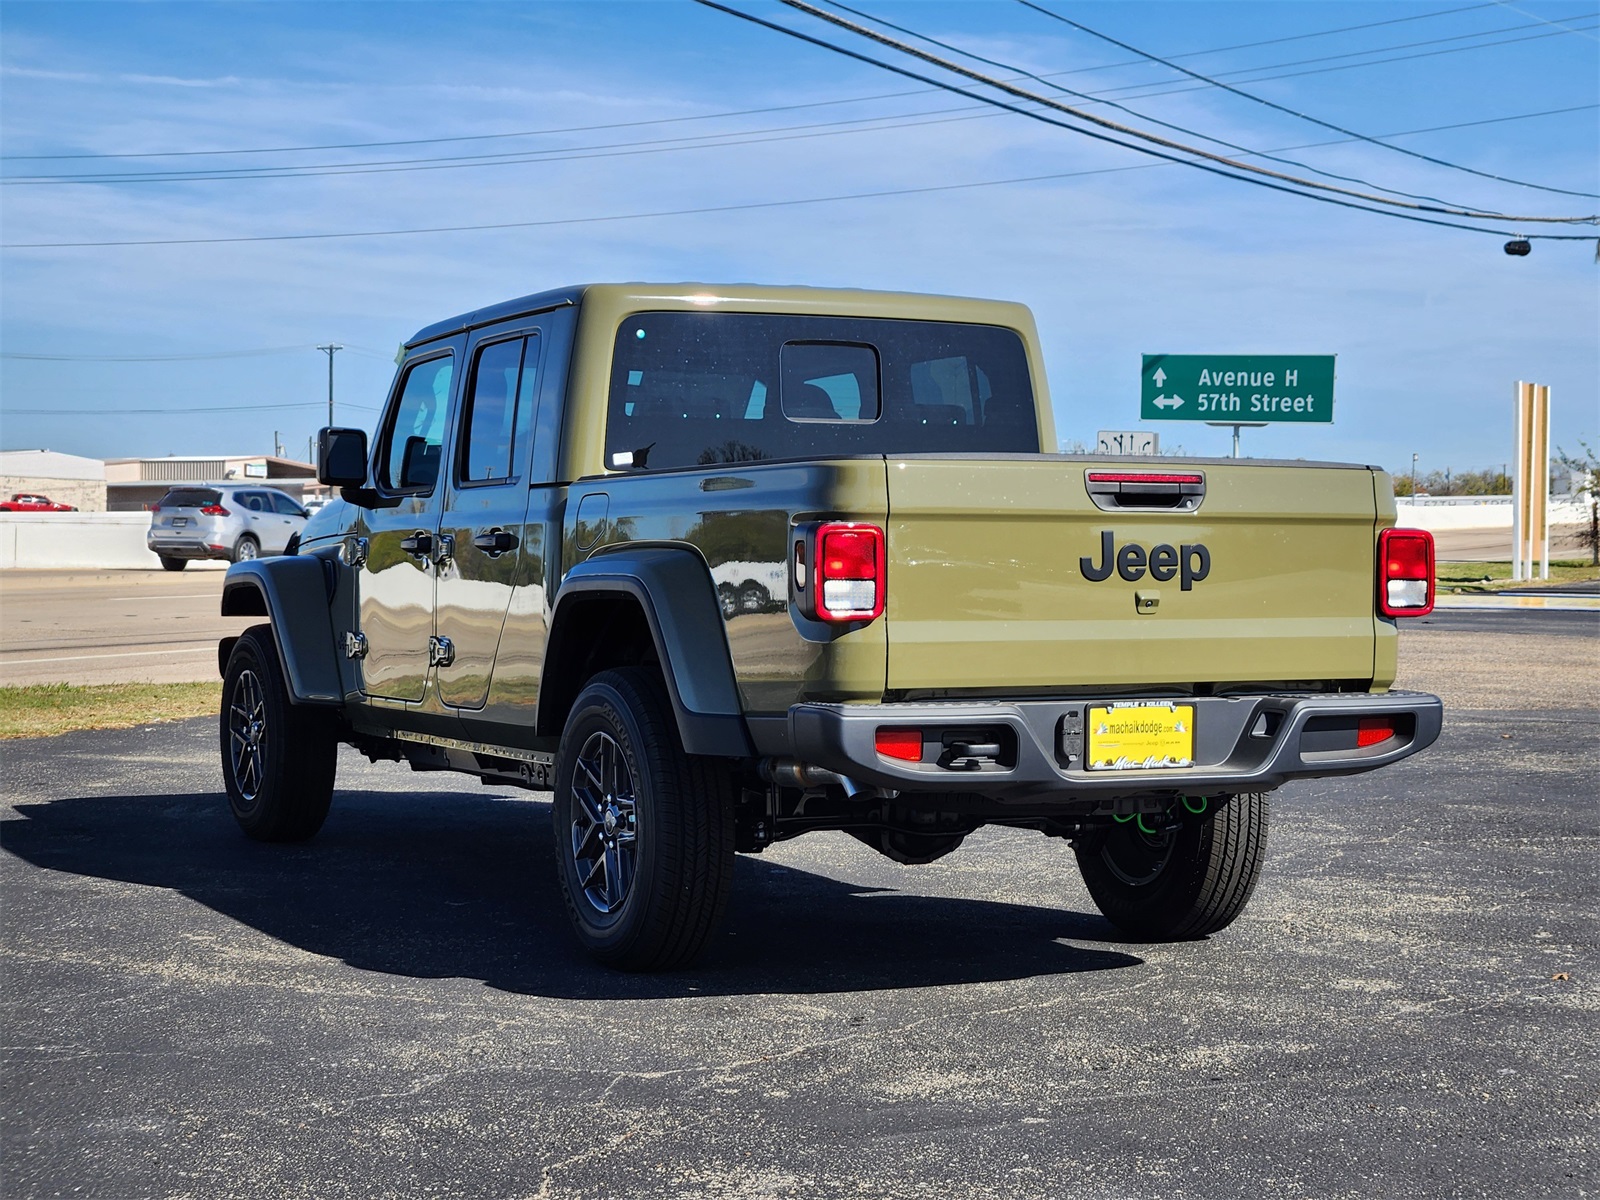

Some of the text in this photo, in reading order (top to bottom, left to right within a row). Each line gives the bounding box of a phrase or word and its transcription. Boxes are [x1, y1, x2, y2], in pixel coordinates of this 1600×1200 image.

[1198, 368, 1298, 387] Avenue H
[1197, 393, 1314, 412] 57th Street
[1079, 530, 1211, 591] Jeep
